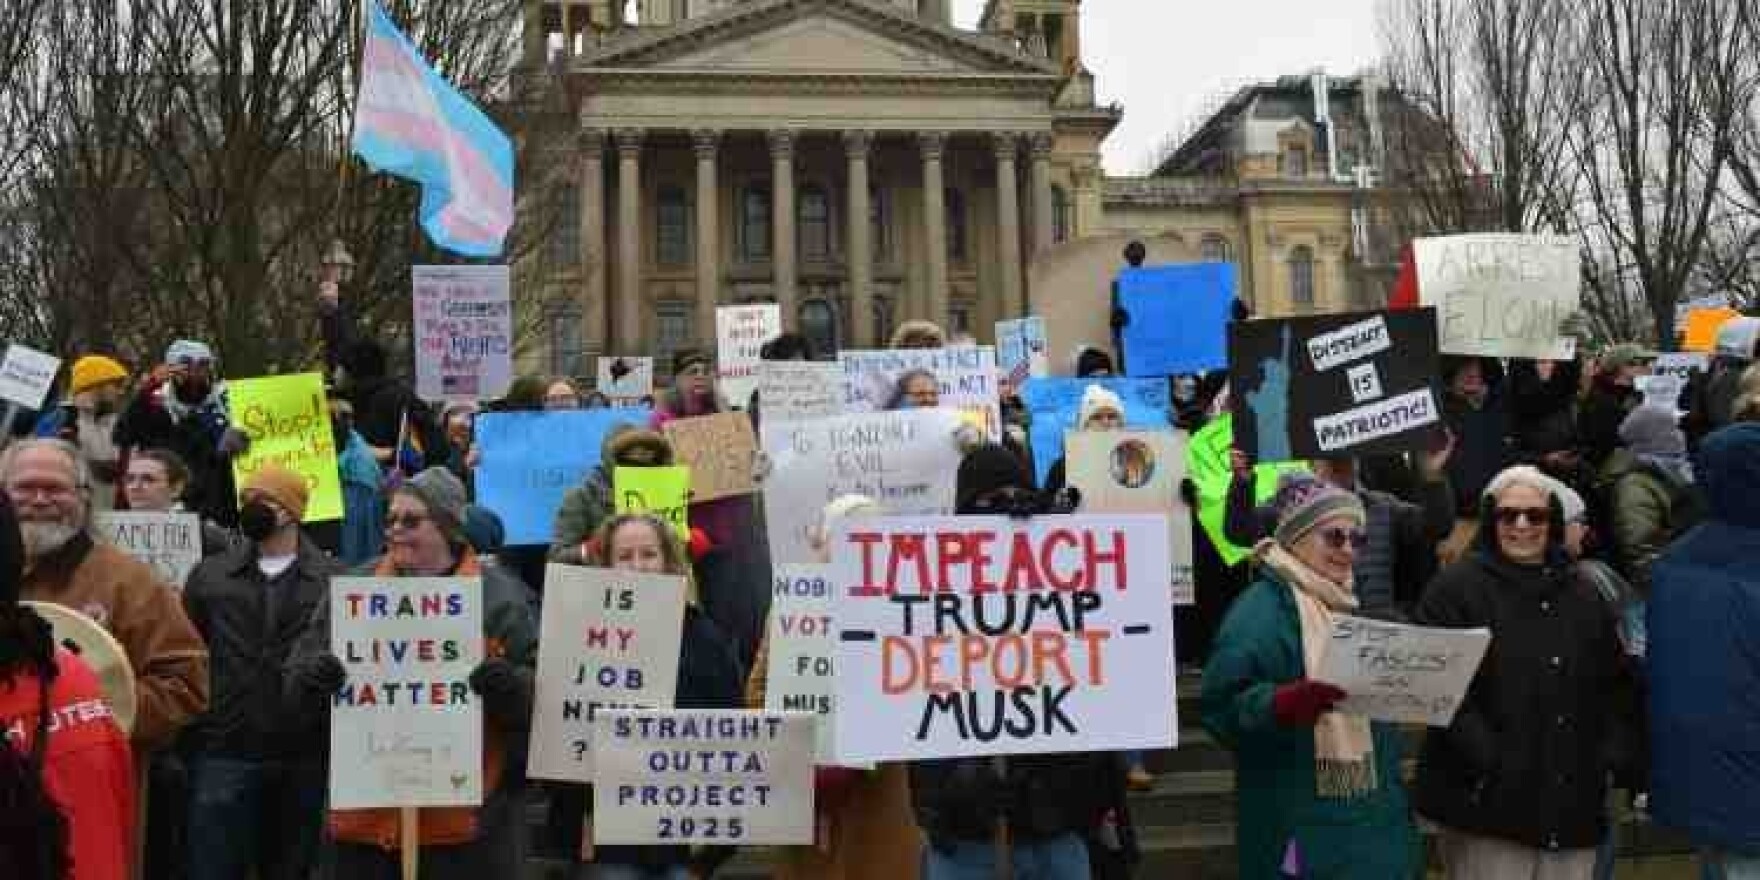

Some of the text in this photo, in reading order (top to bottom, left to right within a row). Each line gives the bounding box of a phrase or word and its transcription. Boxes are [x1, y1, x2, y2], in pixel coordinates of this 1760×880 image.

[1436, 243, 1577, 282] ARREST
[1353, 372, 1373, 393] IS
[113, 522, 159, 550] AME
[847, 529, 1127, 596] IMPEACH
[775, 577, 826, 597] NOB
[345, 594, 463, 617] TRANS
[603, 589, 634, 611] IS
[890, 592, 1101, 636] TRUMP
[780, 616, 831, 636] VOT
[586, 627, 634, 651] MY
[346, 640, 460, 663] LIVES
[881, 629, 1110, 695] DEPORT
[574, 665, 643, 690] JOB
[797, 656, 834, 676] FO
[335, 682, 468, 706] MATTER
[783, 694, 830, 713] MUS
[915, 684, 1078, 742] MUSK
[614, 717, 782, 739] STRAIGHT
[649, 751, 763, 773] OUTTA
[618, 785, 771, 806] PROJECT
[656, 818, 744, 839] 2025
